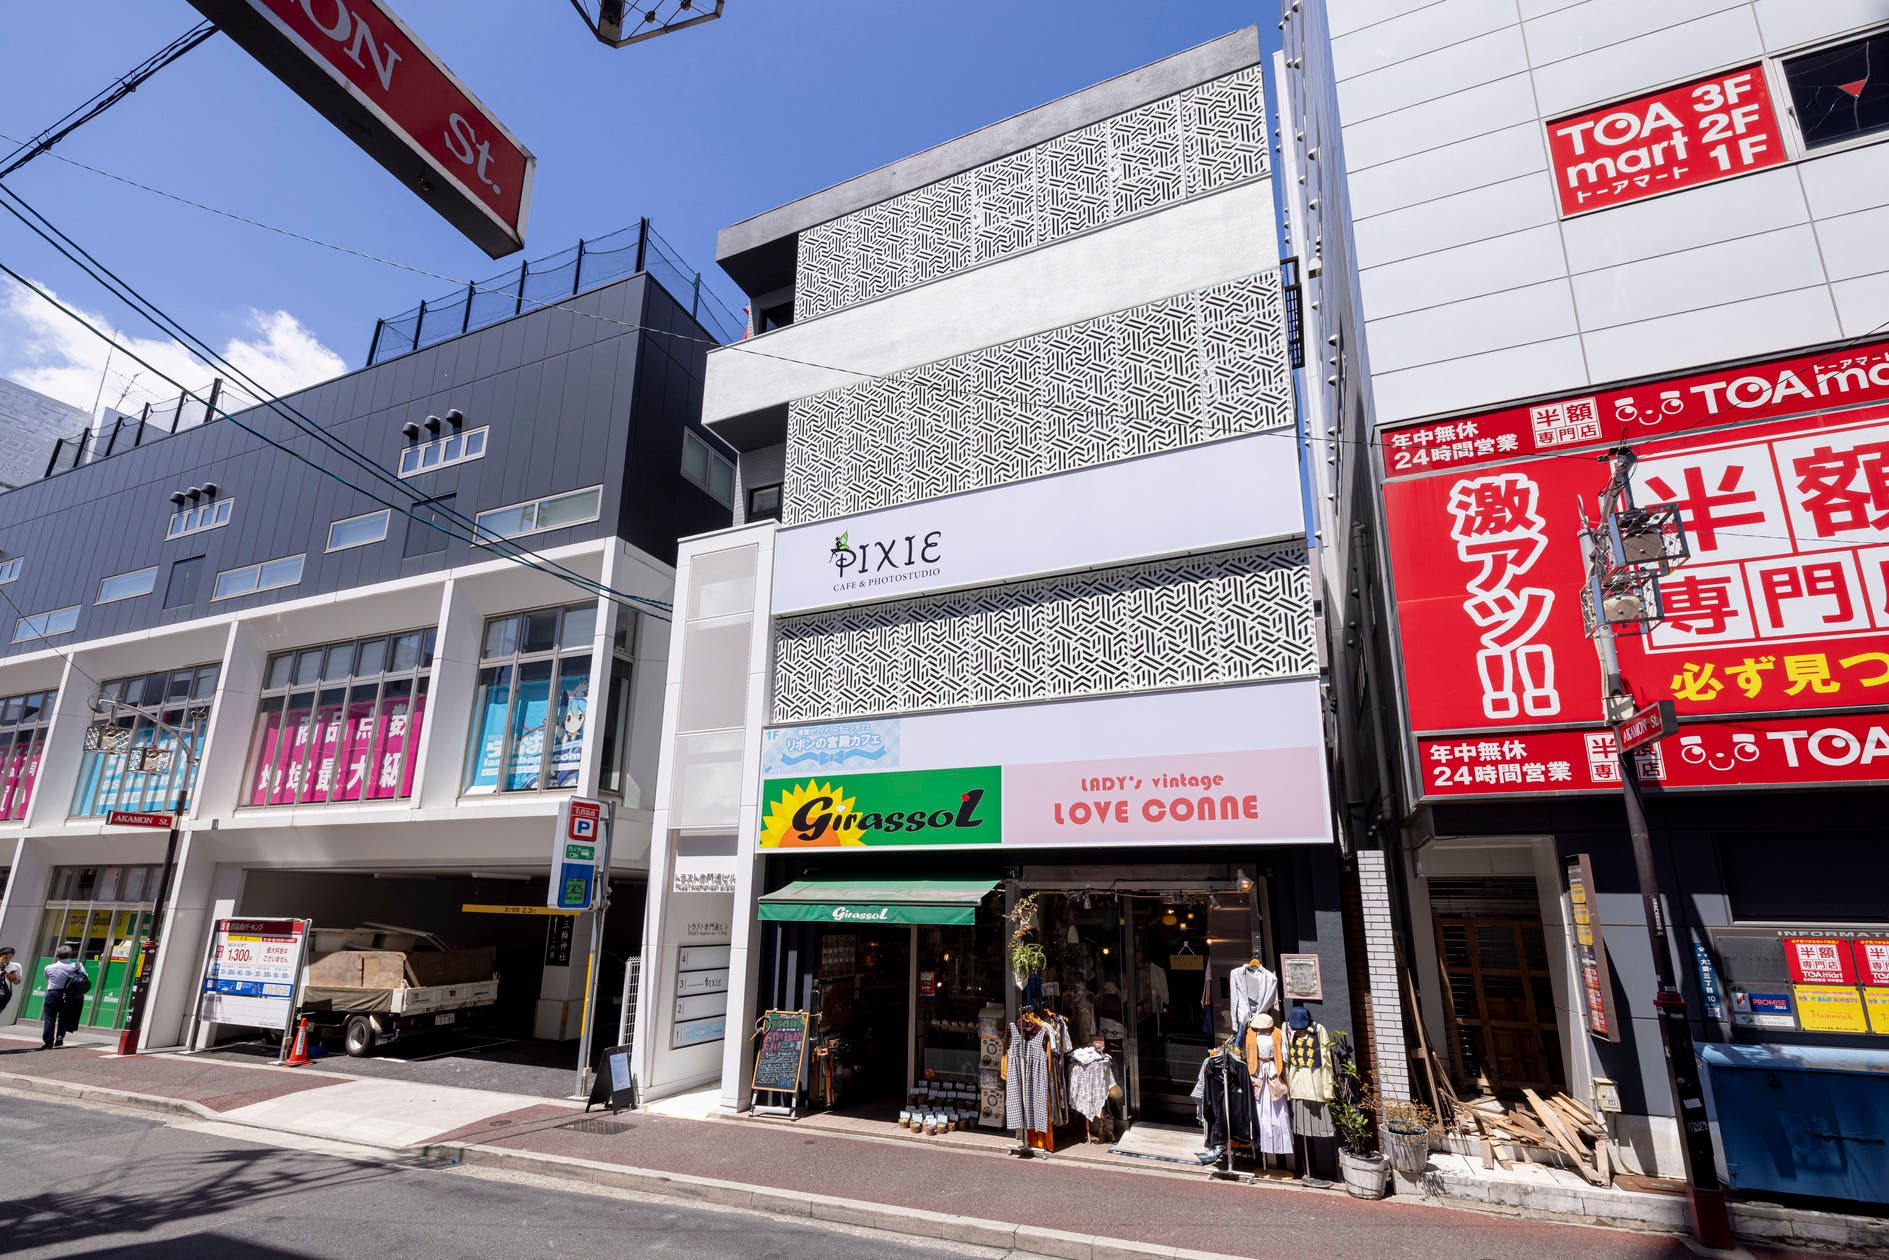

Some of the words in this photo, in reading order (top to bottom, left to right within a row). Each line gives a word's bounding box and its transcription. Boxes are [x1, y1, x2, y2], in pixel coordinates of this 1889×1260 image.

[290, 0, 402, 91] ON
[443, 112, 500, 195] St.
[1692, 74, 1751, 112] 3F
[1557, 102, 1684, 155] TOA
[1699, 104, 1759, 143] 2F
[1566, 131, 1688, 188] mart
[1710, 134, 1767, 171] 1F
[1577, 167, 1688, 203] トーアマート
[1814, 352, 1889, 374] トーアマー
[1690, 370, 1815, 415] TOA
[1537, 402, 1593, 427] 半額
[1391, 421, 1479, 450] 年中無休
[1537, 424, 1598, 445] 専門店
[1394, 433, 1519, 470] 24時間営業
[835, 531, 941, 578] PIXIE
[833, 581, 857, 592] CAFE
[868, 567, 941, 587] PHOTOSTUDIO
[1659, 561, 1889, 635] 専門
[766, 731, 780, 740] 1F
[1622, 721, 1648, 744] AKAMON
[1430, 740, 1528, 763] 年中無休
[1081, 775, 1142, 792] LADY's
[1152, 772, 1225, 791] vintage
[1433, 761, 1572, 786] 24時間営業
[1594, 763, 1660, 779] 専店
[115, 815, 153, 824] AKAMON
[1054, 800, 1129, 825] LOVE
[1141, 795, 1259, 823] CONNE
[577, 820, 590, 834] P
[681, 955, 686, 963] 4
[1801, 946, 1835, 959] 半額
[1802, 960, 1838, 970] 専門店
[680, 980, 684, 988] 3
[1823, 971, 1843, 979] mart
[1752, 998, 1786, 1007] PROMISE
